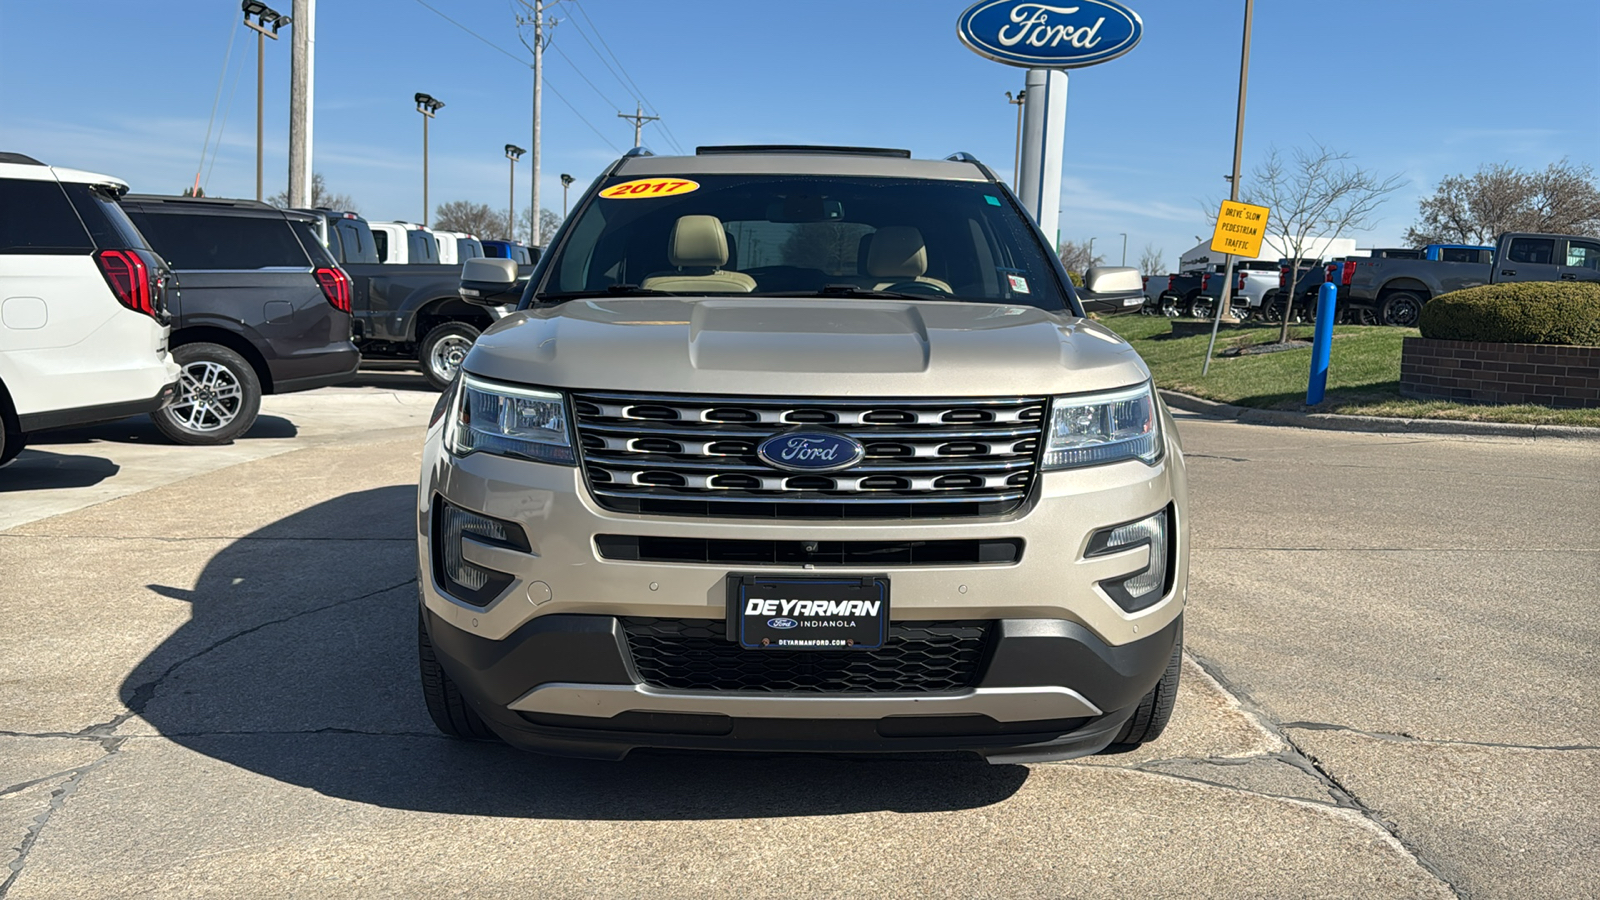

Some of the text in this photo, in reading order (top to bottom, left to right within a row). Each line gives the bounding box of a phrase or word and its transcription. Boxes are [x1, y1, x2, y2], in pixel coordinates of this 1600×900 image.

[998, 3, 1106, 48] Ford
[609, 182, 689, 196] 2017
[1225, 208, 1261, 221] DRIVE SLOW
[1222, 222, 1257, 235] PEDESTRIAN
[1225, 238, 1249, 249] TRAFFIC
[781, 438, 839, 460] Ford
[744, 599, 881, 617] DEYARMAN
[773, 619, 792, 628] Ford
